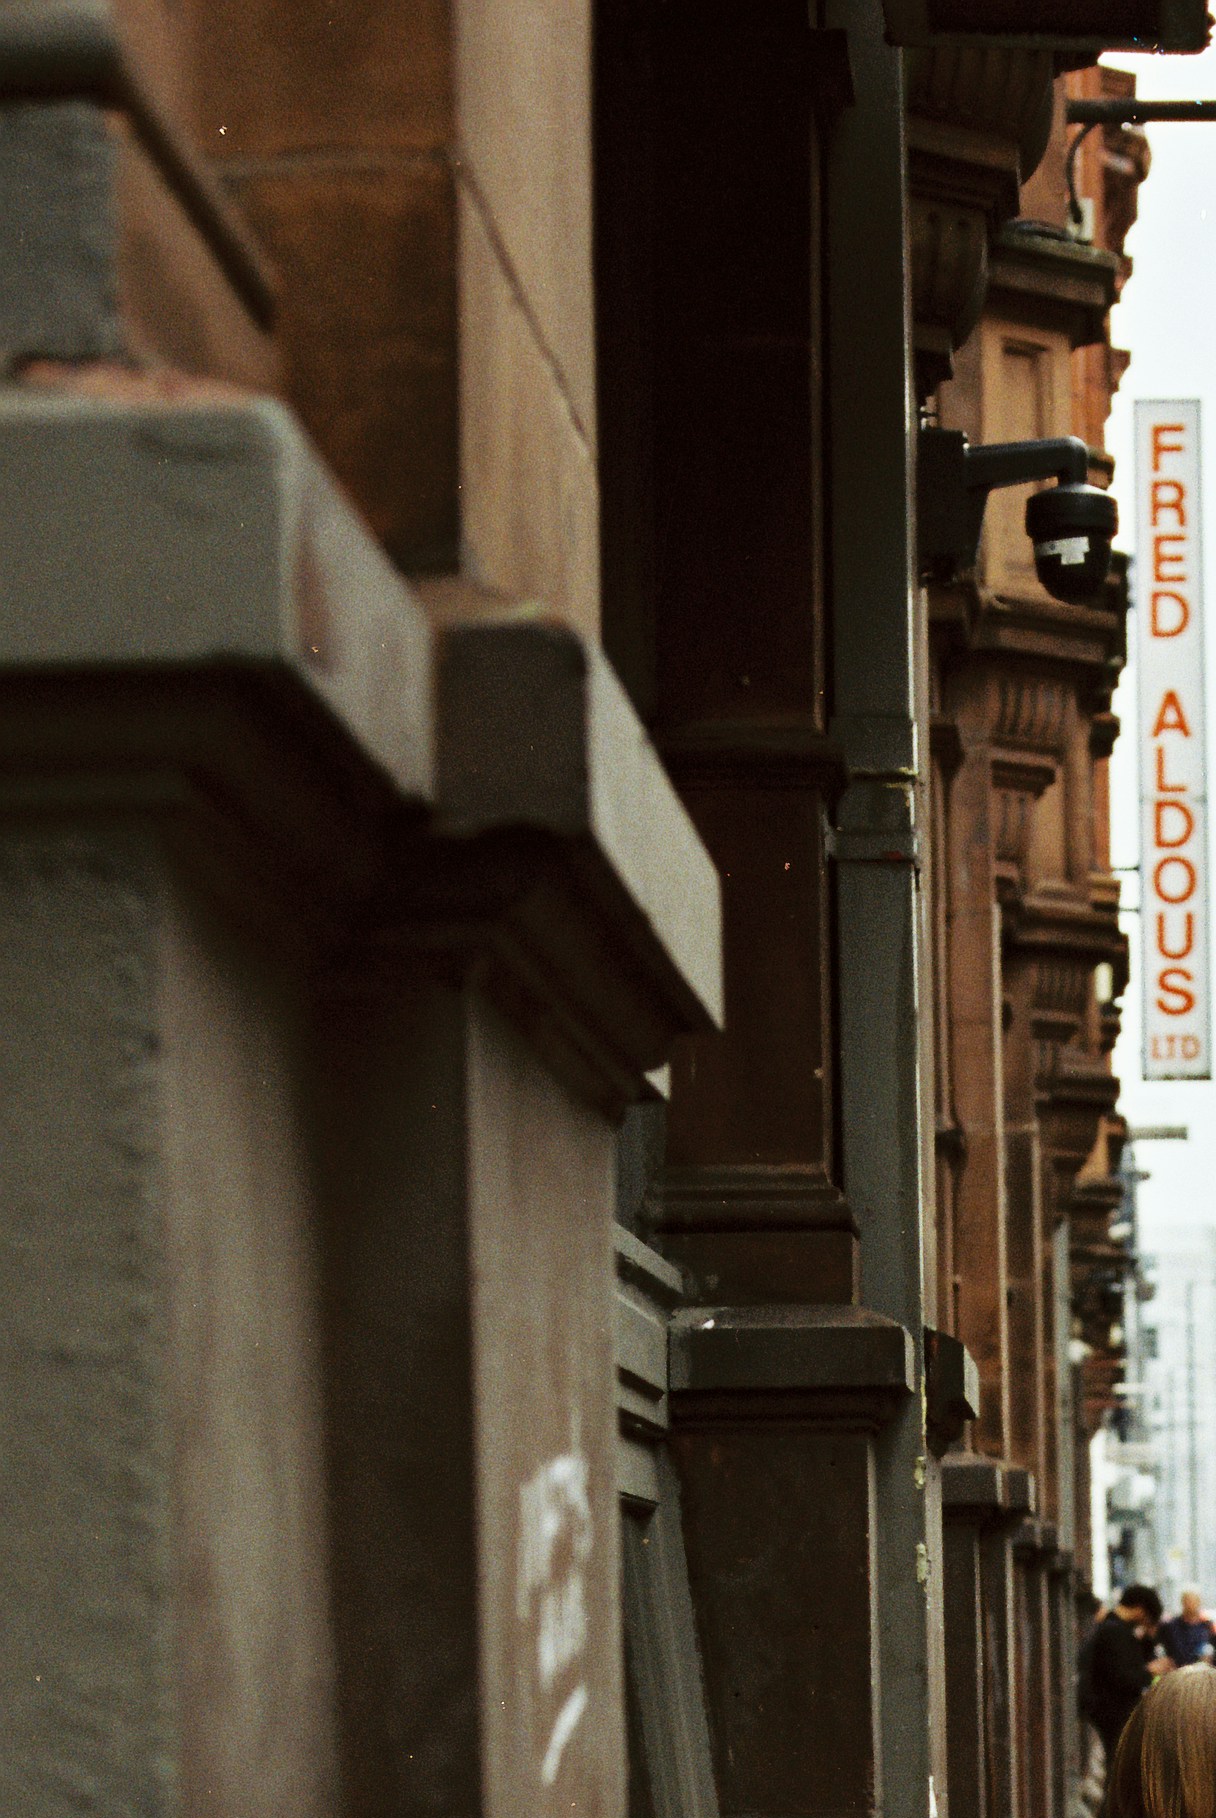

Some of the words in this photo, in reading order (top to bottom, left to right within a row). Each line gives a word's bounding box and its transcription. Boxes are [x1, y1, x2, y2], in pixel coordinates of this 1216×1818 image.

[1150, 423, 1191, 639] FRED
[1151, 689, 1198, 1017] ALDOUS
[1151, 1034, 1201, 1061] LTD
